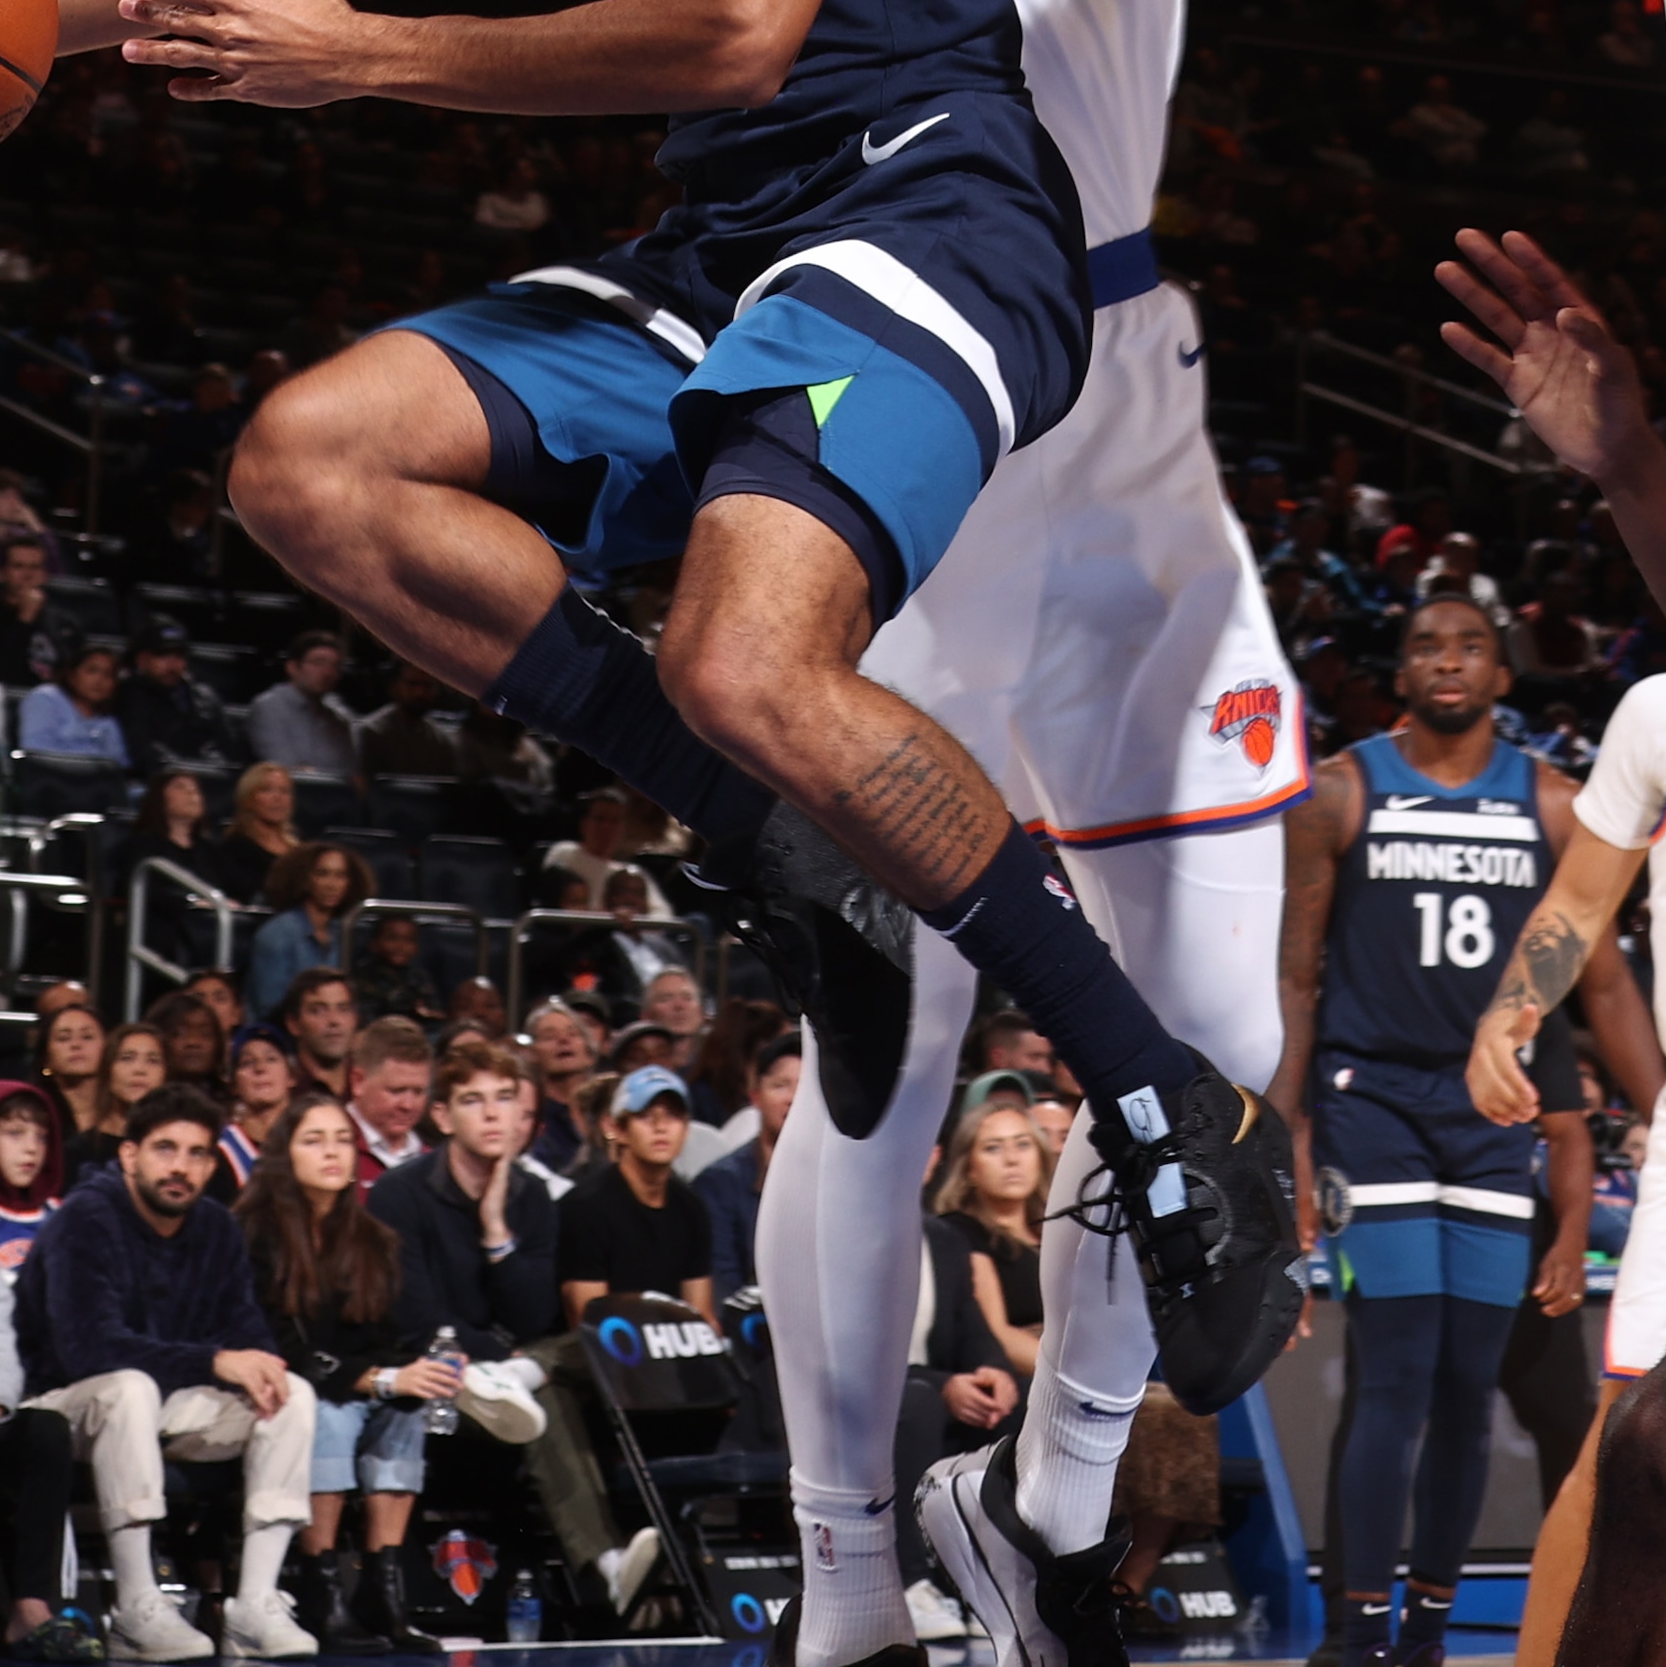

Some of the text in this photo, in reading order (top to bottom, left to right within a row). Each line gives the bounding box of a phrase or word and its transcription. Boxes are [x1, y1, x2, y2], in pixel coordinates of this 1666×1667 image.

[1365, 840, 1539, 888] MINNESOTA
[1412, 892, 1497, 969] 18
[641, 1320, 724, 1360] HUB
[1177, 1590, 1237, 1619] HUB
